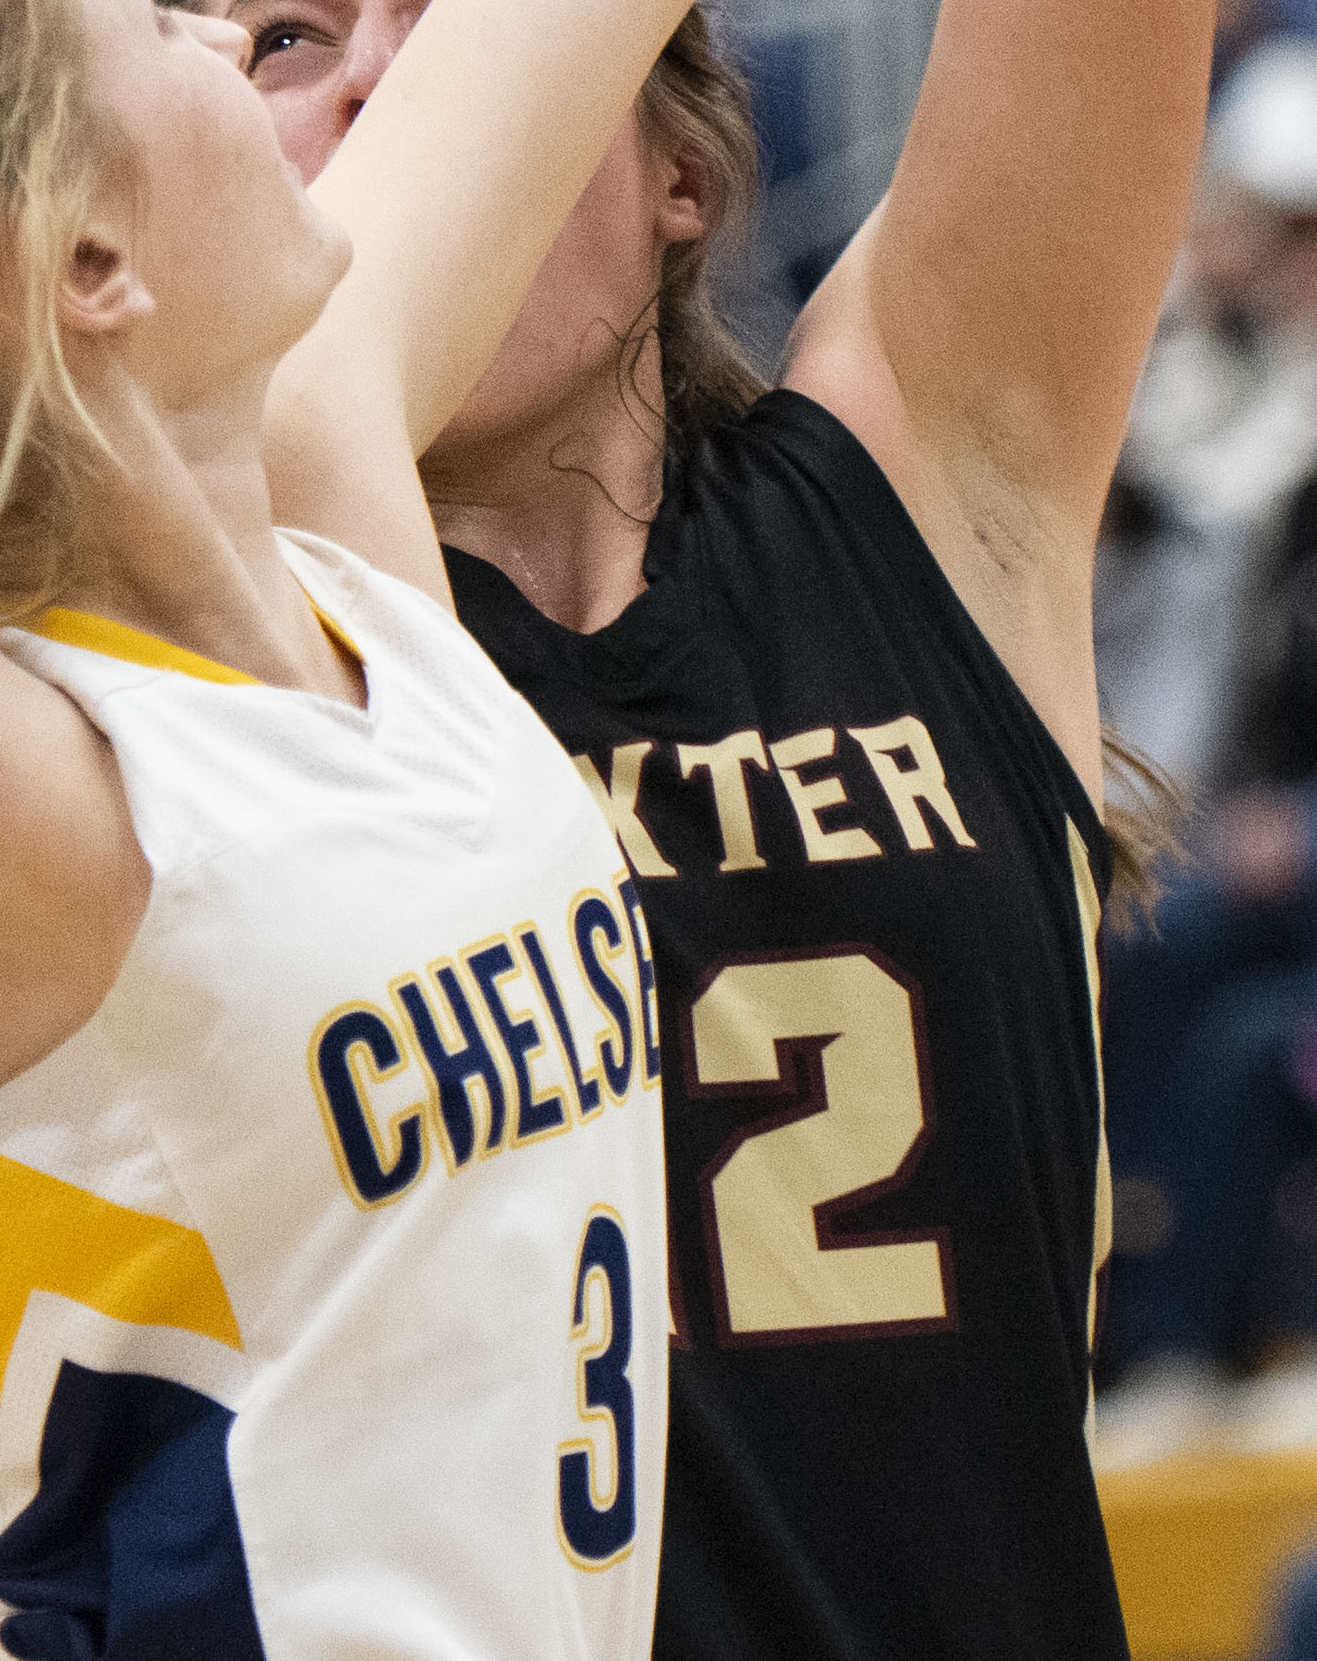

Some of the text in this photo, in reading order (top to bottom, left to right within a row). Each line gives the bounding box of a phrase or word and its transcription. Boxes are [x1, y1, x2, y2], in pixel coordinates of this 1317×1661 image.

[571, 713, 979, 880] XTER
[308, 870, 662, 1210] CHELSE
[667, 946, 957, 1342] 2
[555, 1203, 639, 1571] 3
